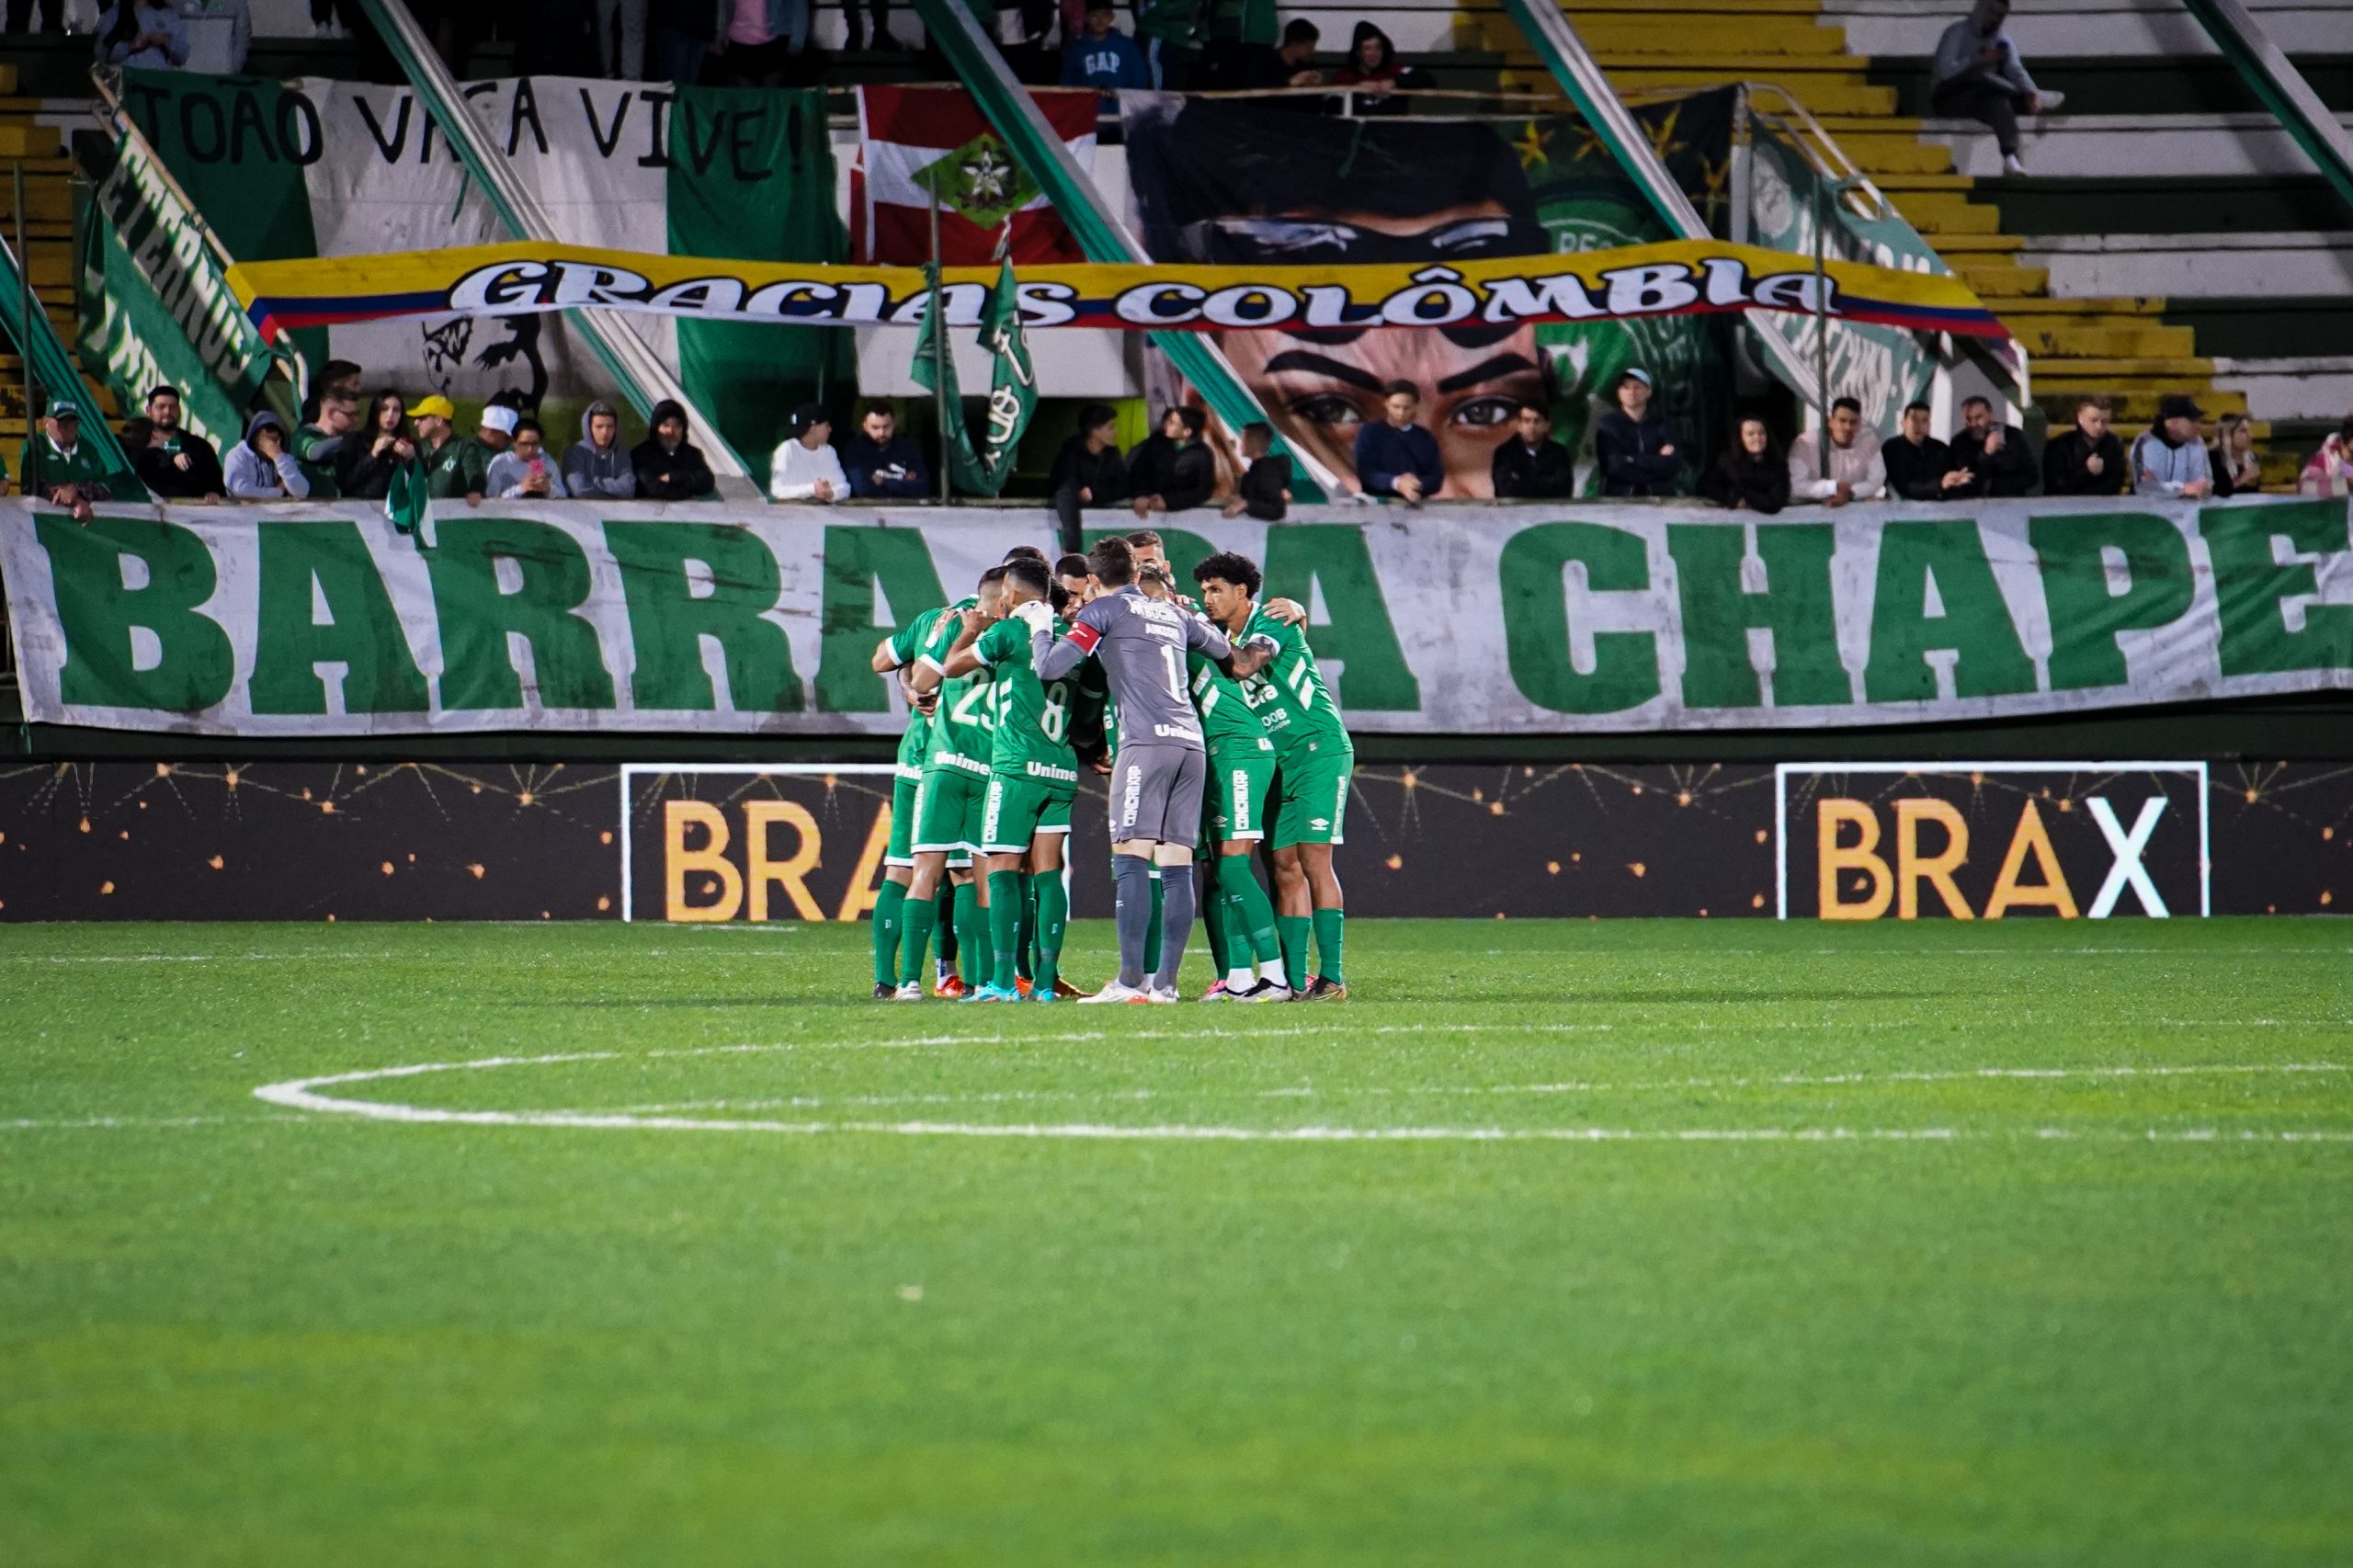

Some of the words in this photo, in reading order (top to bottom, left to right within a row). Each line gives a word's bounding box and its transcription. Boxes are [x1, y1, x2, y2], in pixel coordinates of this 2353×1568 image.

[1086, 51, 1120, 75] GAP
[352, 77, 550, 165] VAA
[449, 259, 1077, 327] GRACIAS
[1113, 257, 1842, 327] COLÔMBIA
[33, 513, 950, 714] BARRA
[1499, 499, 2353, 714] CHAPE
[1160, 643, 1185, 704] 1
[1040, 682, 1068, 743] 8
[934, 751, 993, 776] Unime
[1027, 761, 1078, 782] Unime
[665, 799, 894, 923] BRA
[1816, 796, 2171, 920] BRAX
